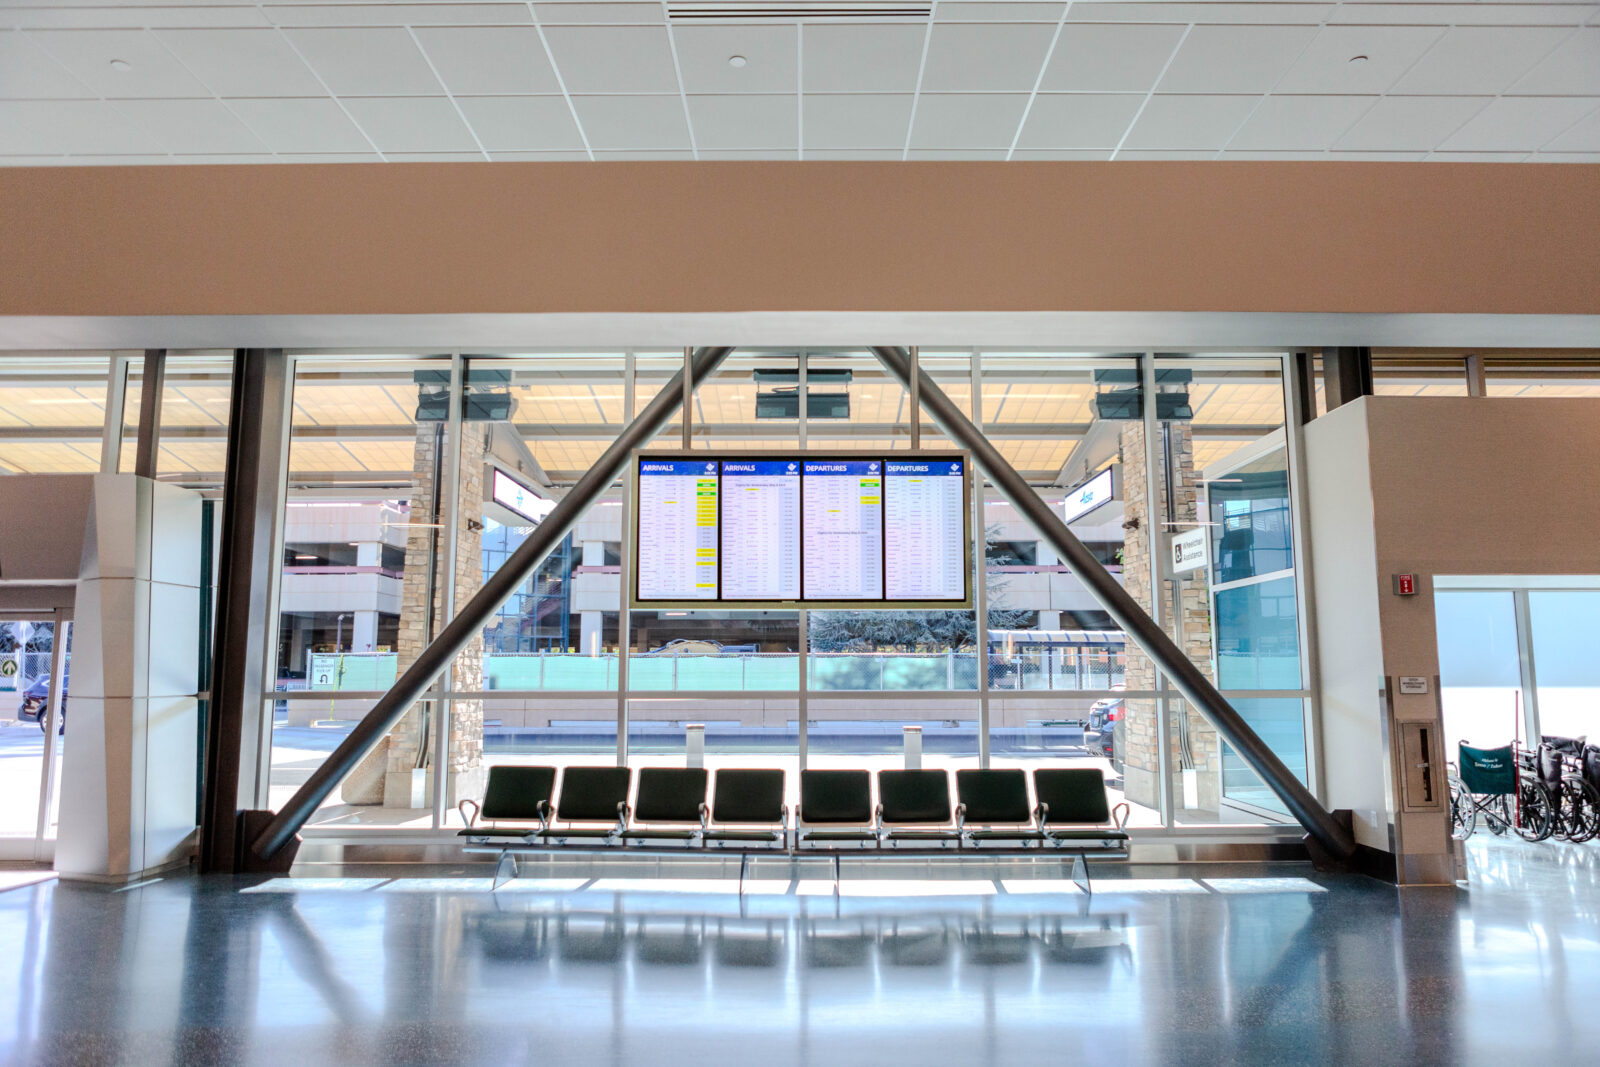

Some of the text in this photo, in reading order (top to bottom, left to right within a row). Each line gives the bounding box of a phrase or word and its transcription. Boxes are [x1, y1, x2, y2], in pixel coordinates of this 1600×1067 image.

[643, 464, 674, 472] ARRIVALS
[724, 464, 756, 472] ARRIVALS
[805, 464, 848, 472] DEPARTURES
[887, 464, 929, 472] DEPARTURES
[1183, 550, 1203, 560] Assistance
